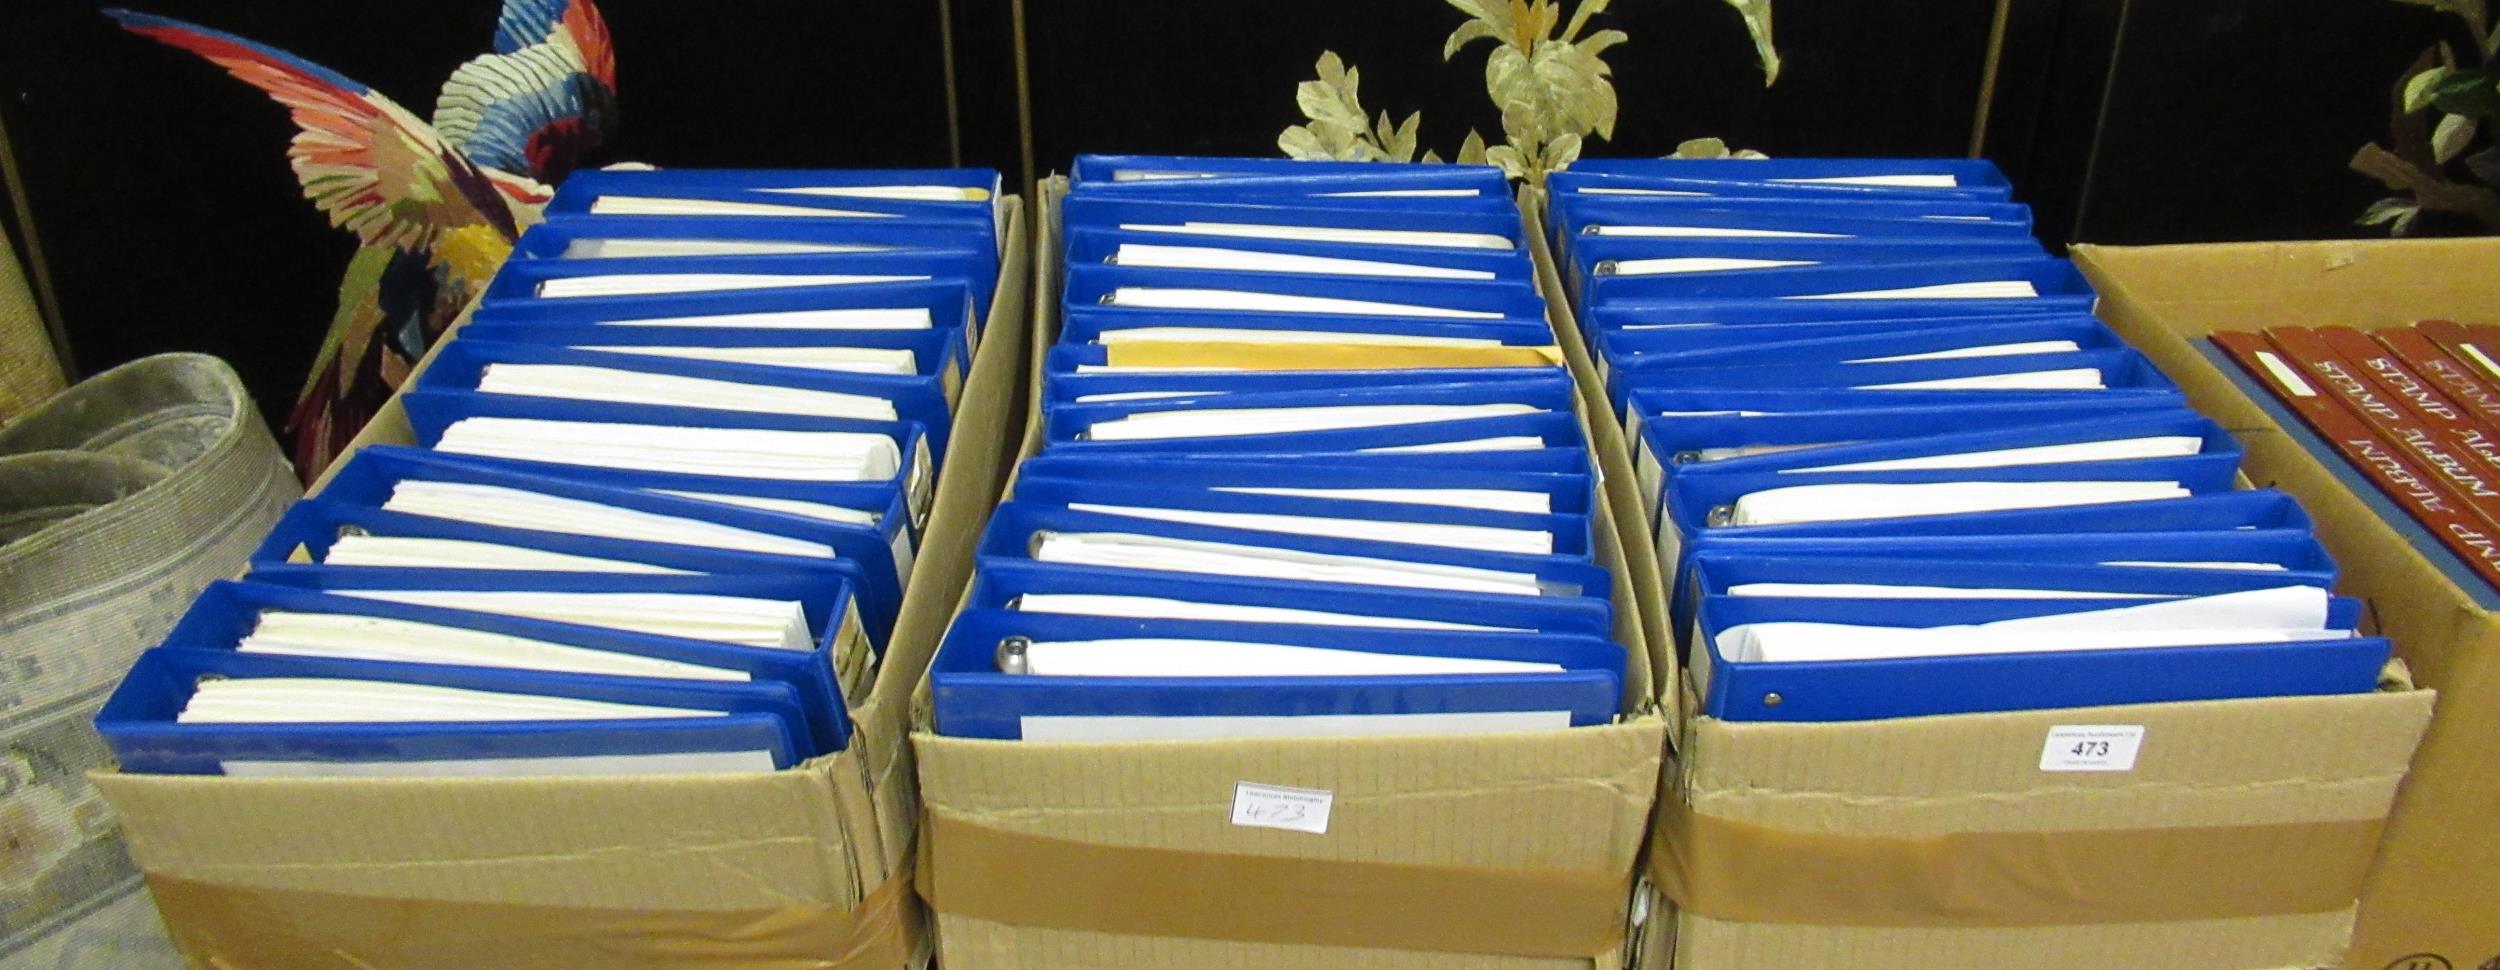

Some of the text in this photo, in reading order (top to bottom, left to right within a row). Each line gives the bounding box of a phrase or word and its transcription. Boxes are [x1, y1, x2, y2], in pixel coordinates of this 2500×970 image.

[2366, 357, 2457, 420] STAMP
[2314, 359, 2500, 498] STAMP ALBUM
[2348, 439, 2456, 515] ALBUM
[2071, 740, 2110, 756] 473
